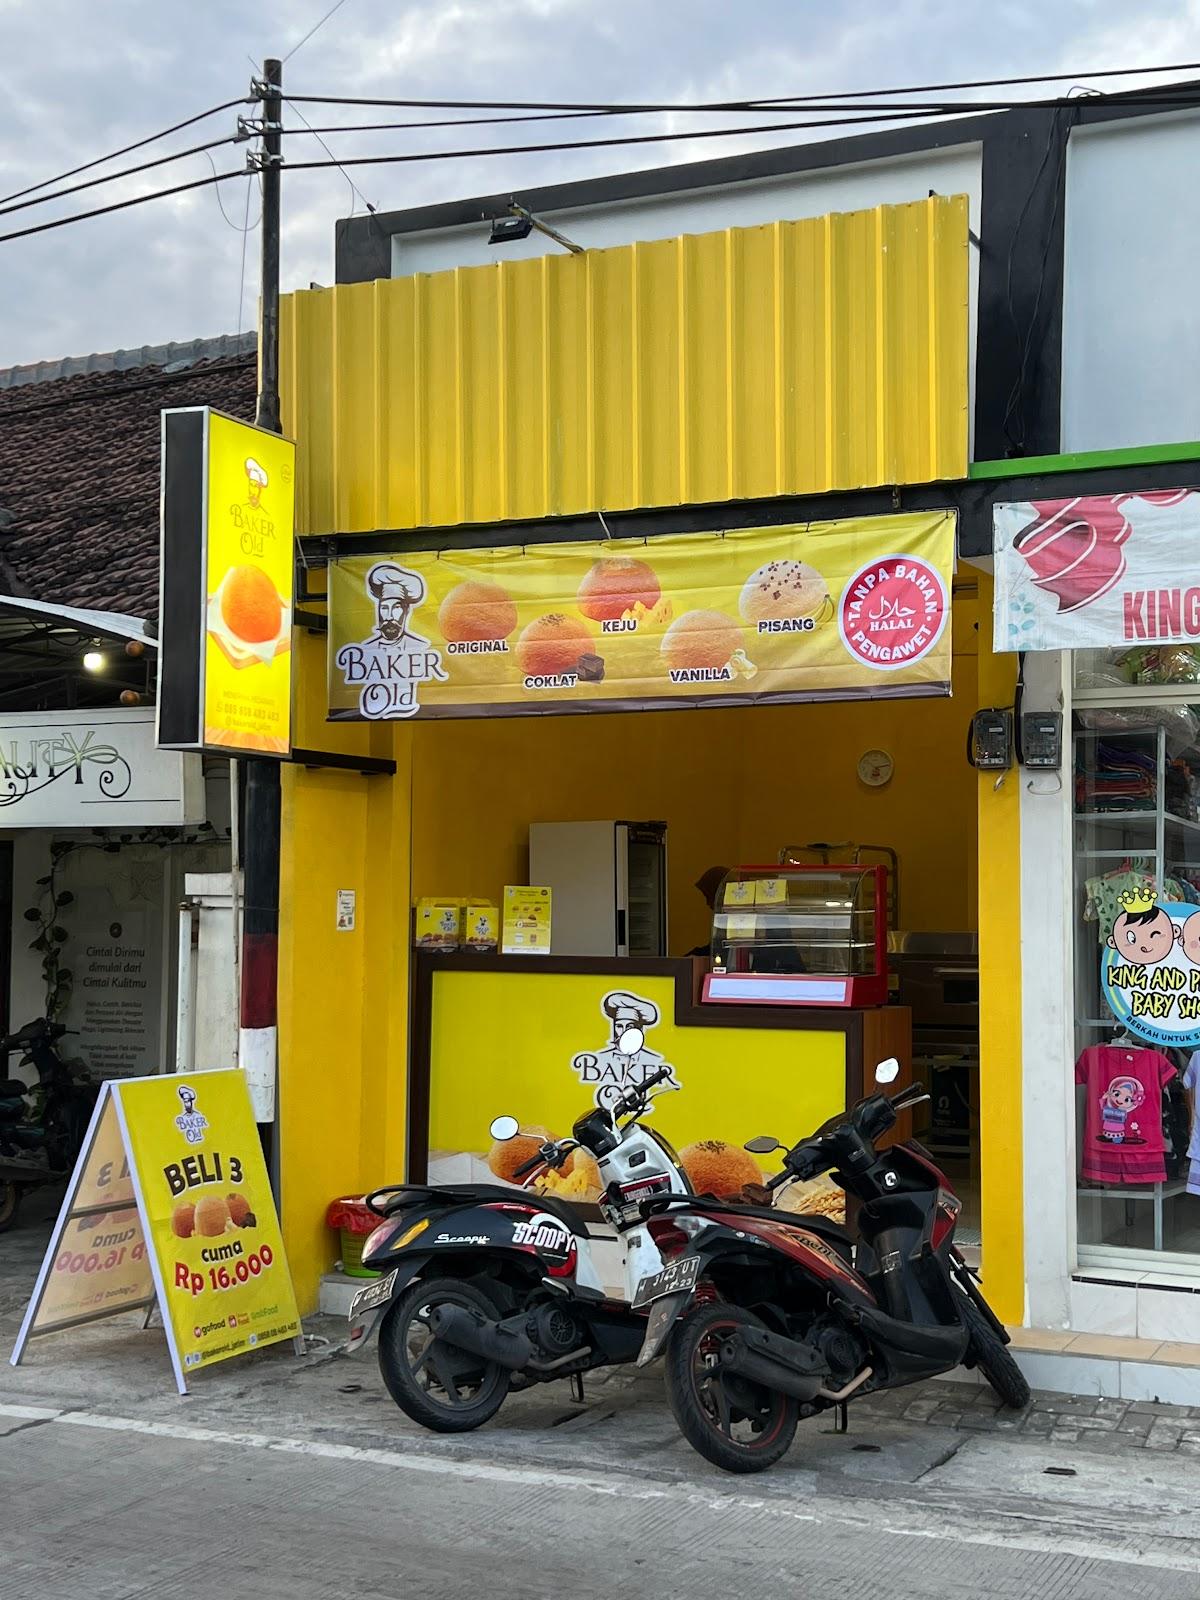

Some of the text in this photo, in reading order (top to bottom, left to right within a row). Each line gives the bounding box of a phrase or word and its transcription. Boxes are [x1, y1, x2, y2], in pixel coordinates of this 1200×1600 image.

[230, 504, 277, 540] BAKER
[240, 532, 264, 557] Old
[848, 565, 938, 621] TANPA BAHAN
[869, 596, 916, 618] حلال
[1123, 587, 1200, 640] KING
[602, 619, 637, 632] KEJU
[758, 619, 815, 633] PISANG
[869, 619, 914, 631] HALAL
[447, 639, 509, 654] ORIGINAL
[851, 625, 932, 660] PENGAWET
[338, 647, 446, 681] BAKER
[669, 668, 731, 682] VANILLA
[523, 675, 577, 688] COKLAT
[363, 683, 419, 716] Old
[1107, 965, 1147, 991] KING
[1150, 966, 1187, 992] AND
[1131, 991, 1175, 1018] BABY
[1126, 1014, 1159, 1039] BERKAH
[1161, 1032, 1192, 1042] UNTUK
[177, 1116, 208, 1132] BAKER
[186, 1129, 203, 1143] Old
[164, 1152, 223, 1196] BELI
[230, 1157, 243, 1184] 3
[434, 1233, 490, 1245] Scoopy
[511, 1221, 574, 1253] SCOOPY
[201, 1240, 243, 1263] cuma
[175, 1244, 273, 1295] Rp 16.000
[201, 1319, 226, 1336] gofood
